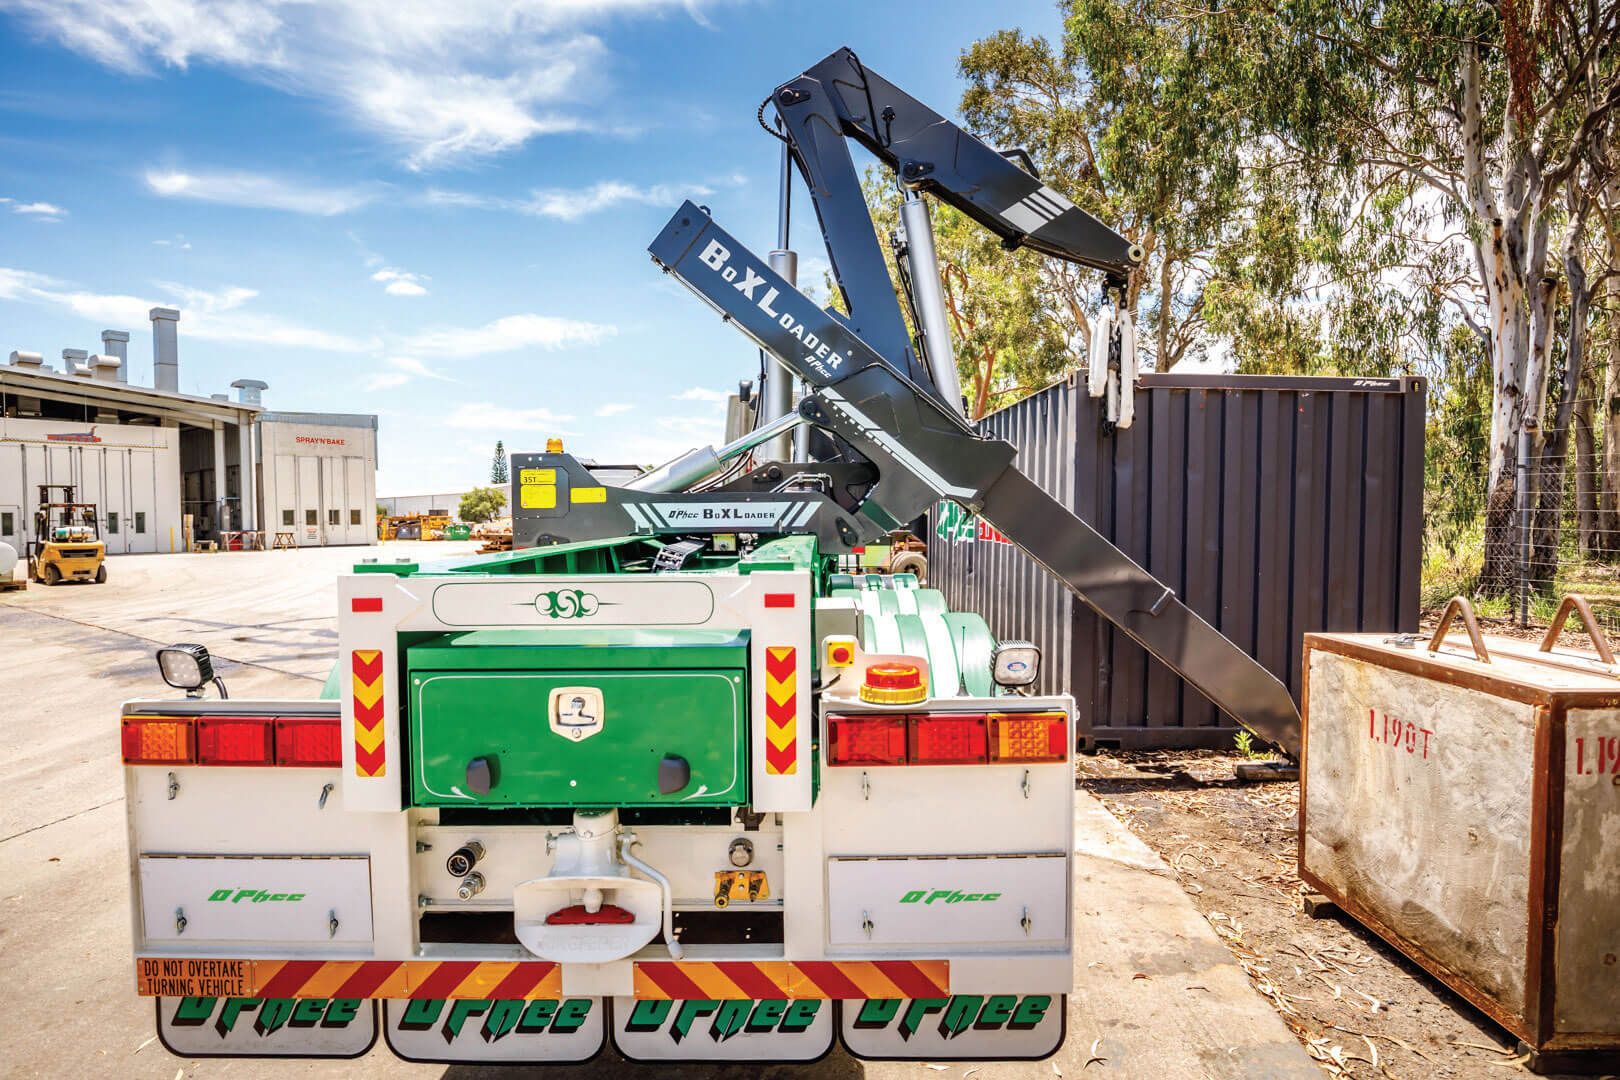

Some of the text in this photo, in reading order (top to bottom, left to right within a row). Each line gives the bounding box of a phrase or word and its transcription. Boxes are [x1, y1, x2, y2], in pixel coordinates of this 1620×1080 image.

[1369, 708, 1434, 760] 1.190T
[144, 960, 244, 978] DO NOT OVERTAKE
[147, 978, 244, 996] TURNING VEHICLE
